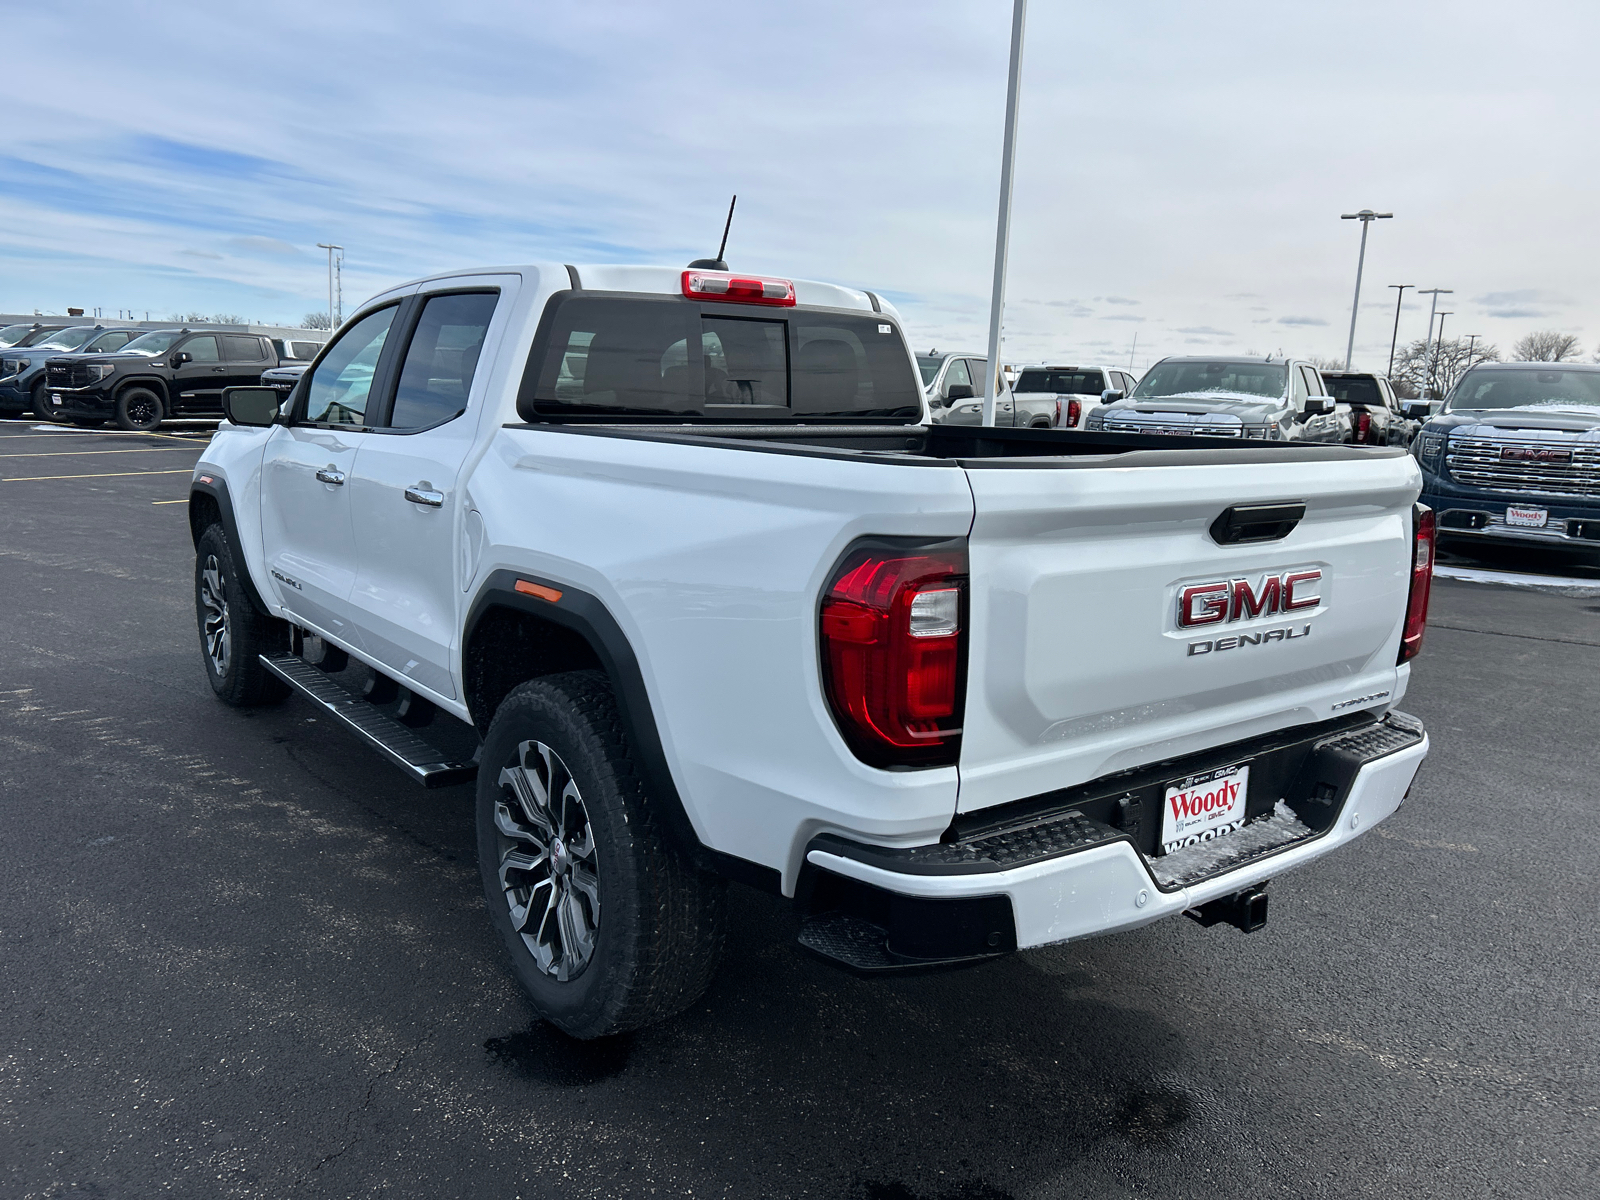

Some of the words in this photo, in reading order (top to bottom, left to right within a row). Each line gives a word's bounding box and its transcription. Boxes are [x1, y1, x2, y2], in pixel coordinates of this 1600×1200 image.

[1503, 448, 1570, 462] GMC
[1511, 510, 1543, 520] Woody
[1175, 568, 1323, 630] GMC
[1187, 622, 1312, 657] DENALI
[1169, 780, 1241, 821] Woody
